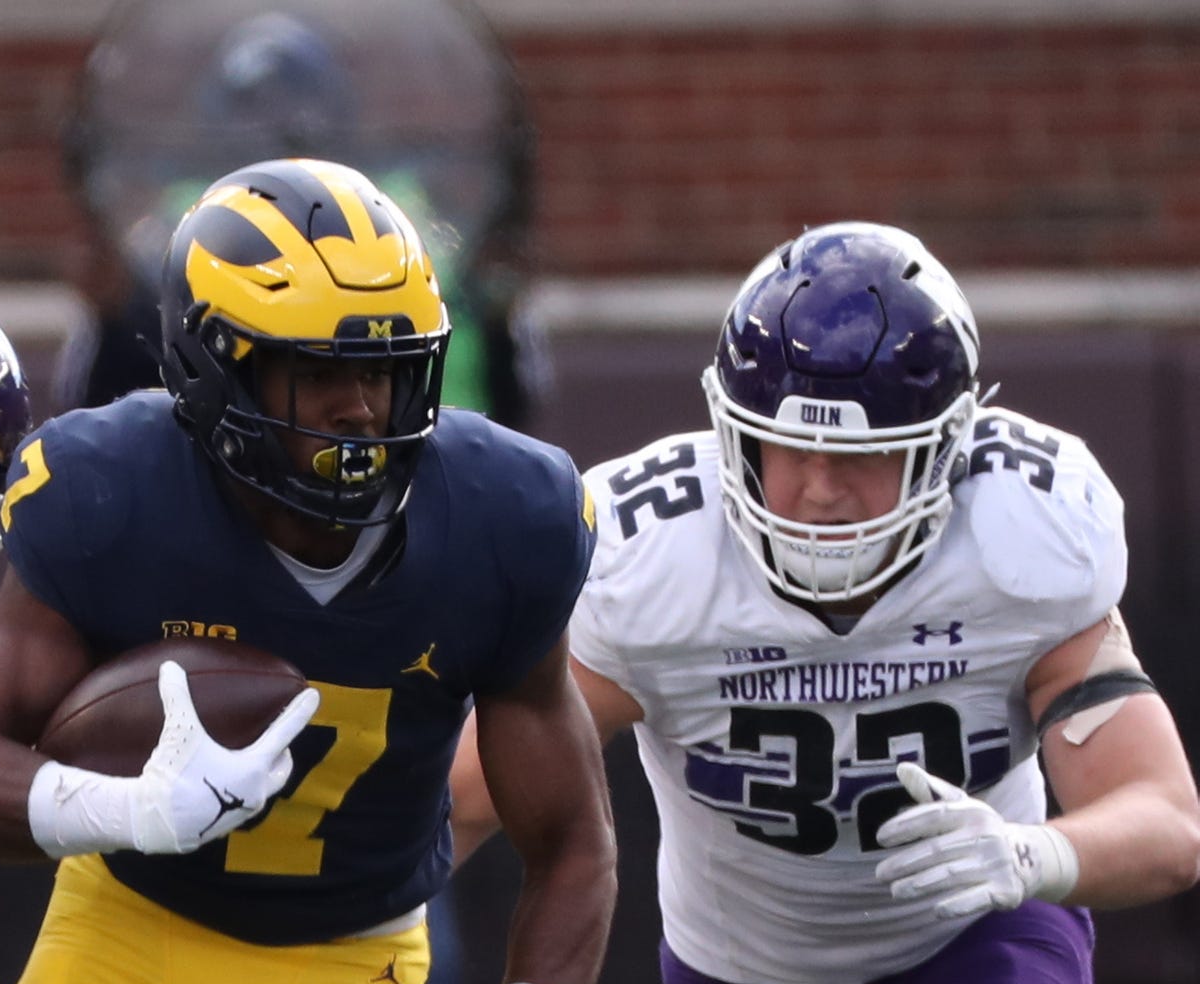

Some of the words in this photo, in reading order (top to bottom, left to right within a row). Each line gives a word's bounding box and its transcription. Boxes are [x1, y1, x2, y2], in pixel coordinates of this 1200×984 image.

[368, 320, 393, 338] M
[801, 404, 843, 427] WIN
[611, 443, 704, 540] 32
[718, 660, 969, 702] NORTHWESTERN
[224, 681, 393, 877] 7
[729, 701, 967, 857] 32
